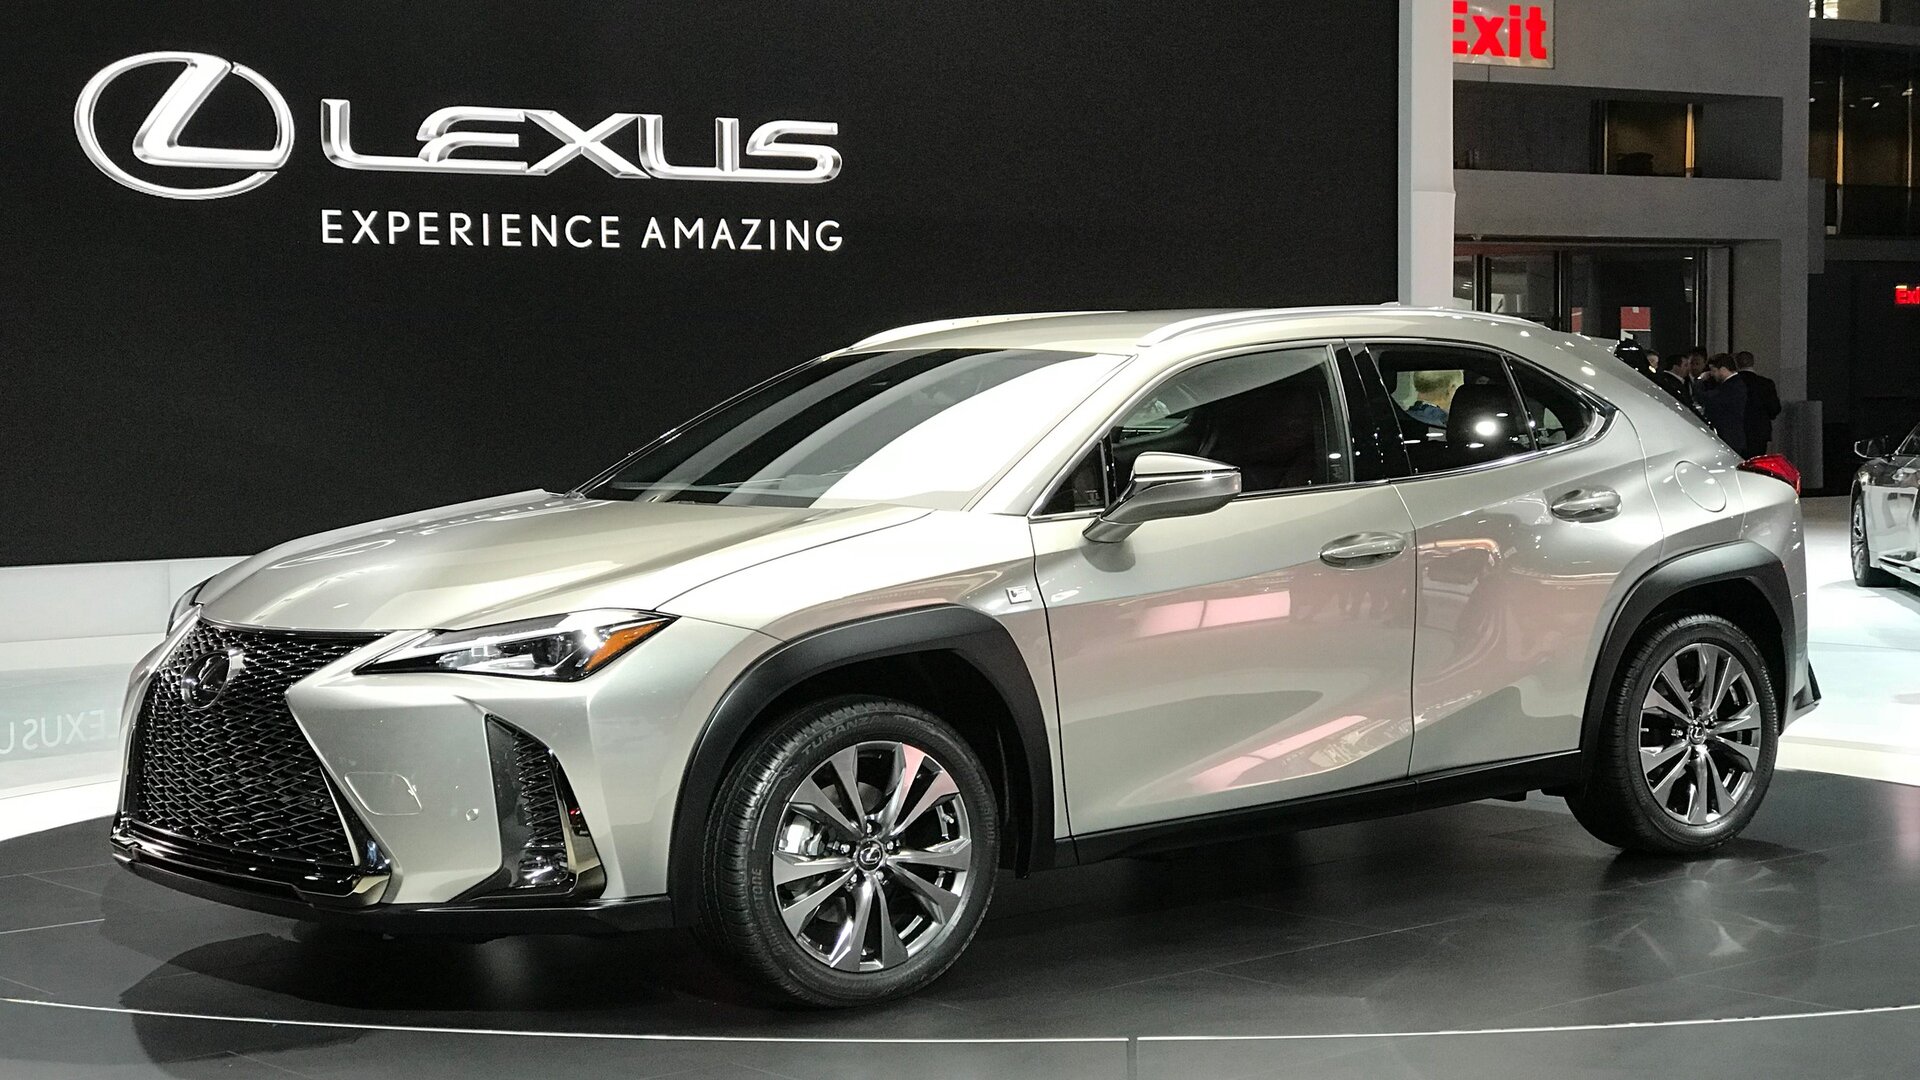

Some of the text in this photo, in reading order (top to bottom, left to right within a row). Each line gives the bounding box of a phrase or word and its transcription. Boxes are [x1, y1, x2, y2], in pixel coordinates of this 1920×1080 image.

[320, 98, 843, 184] LEXUS
[321, 209, 843, 252] EXPERIENCE AMAZING
